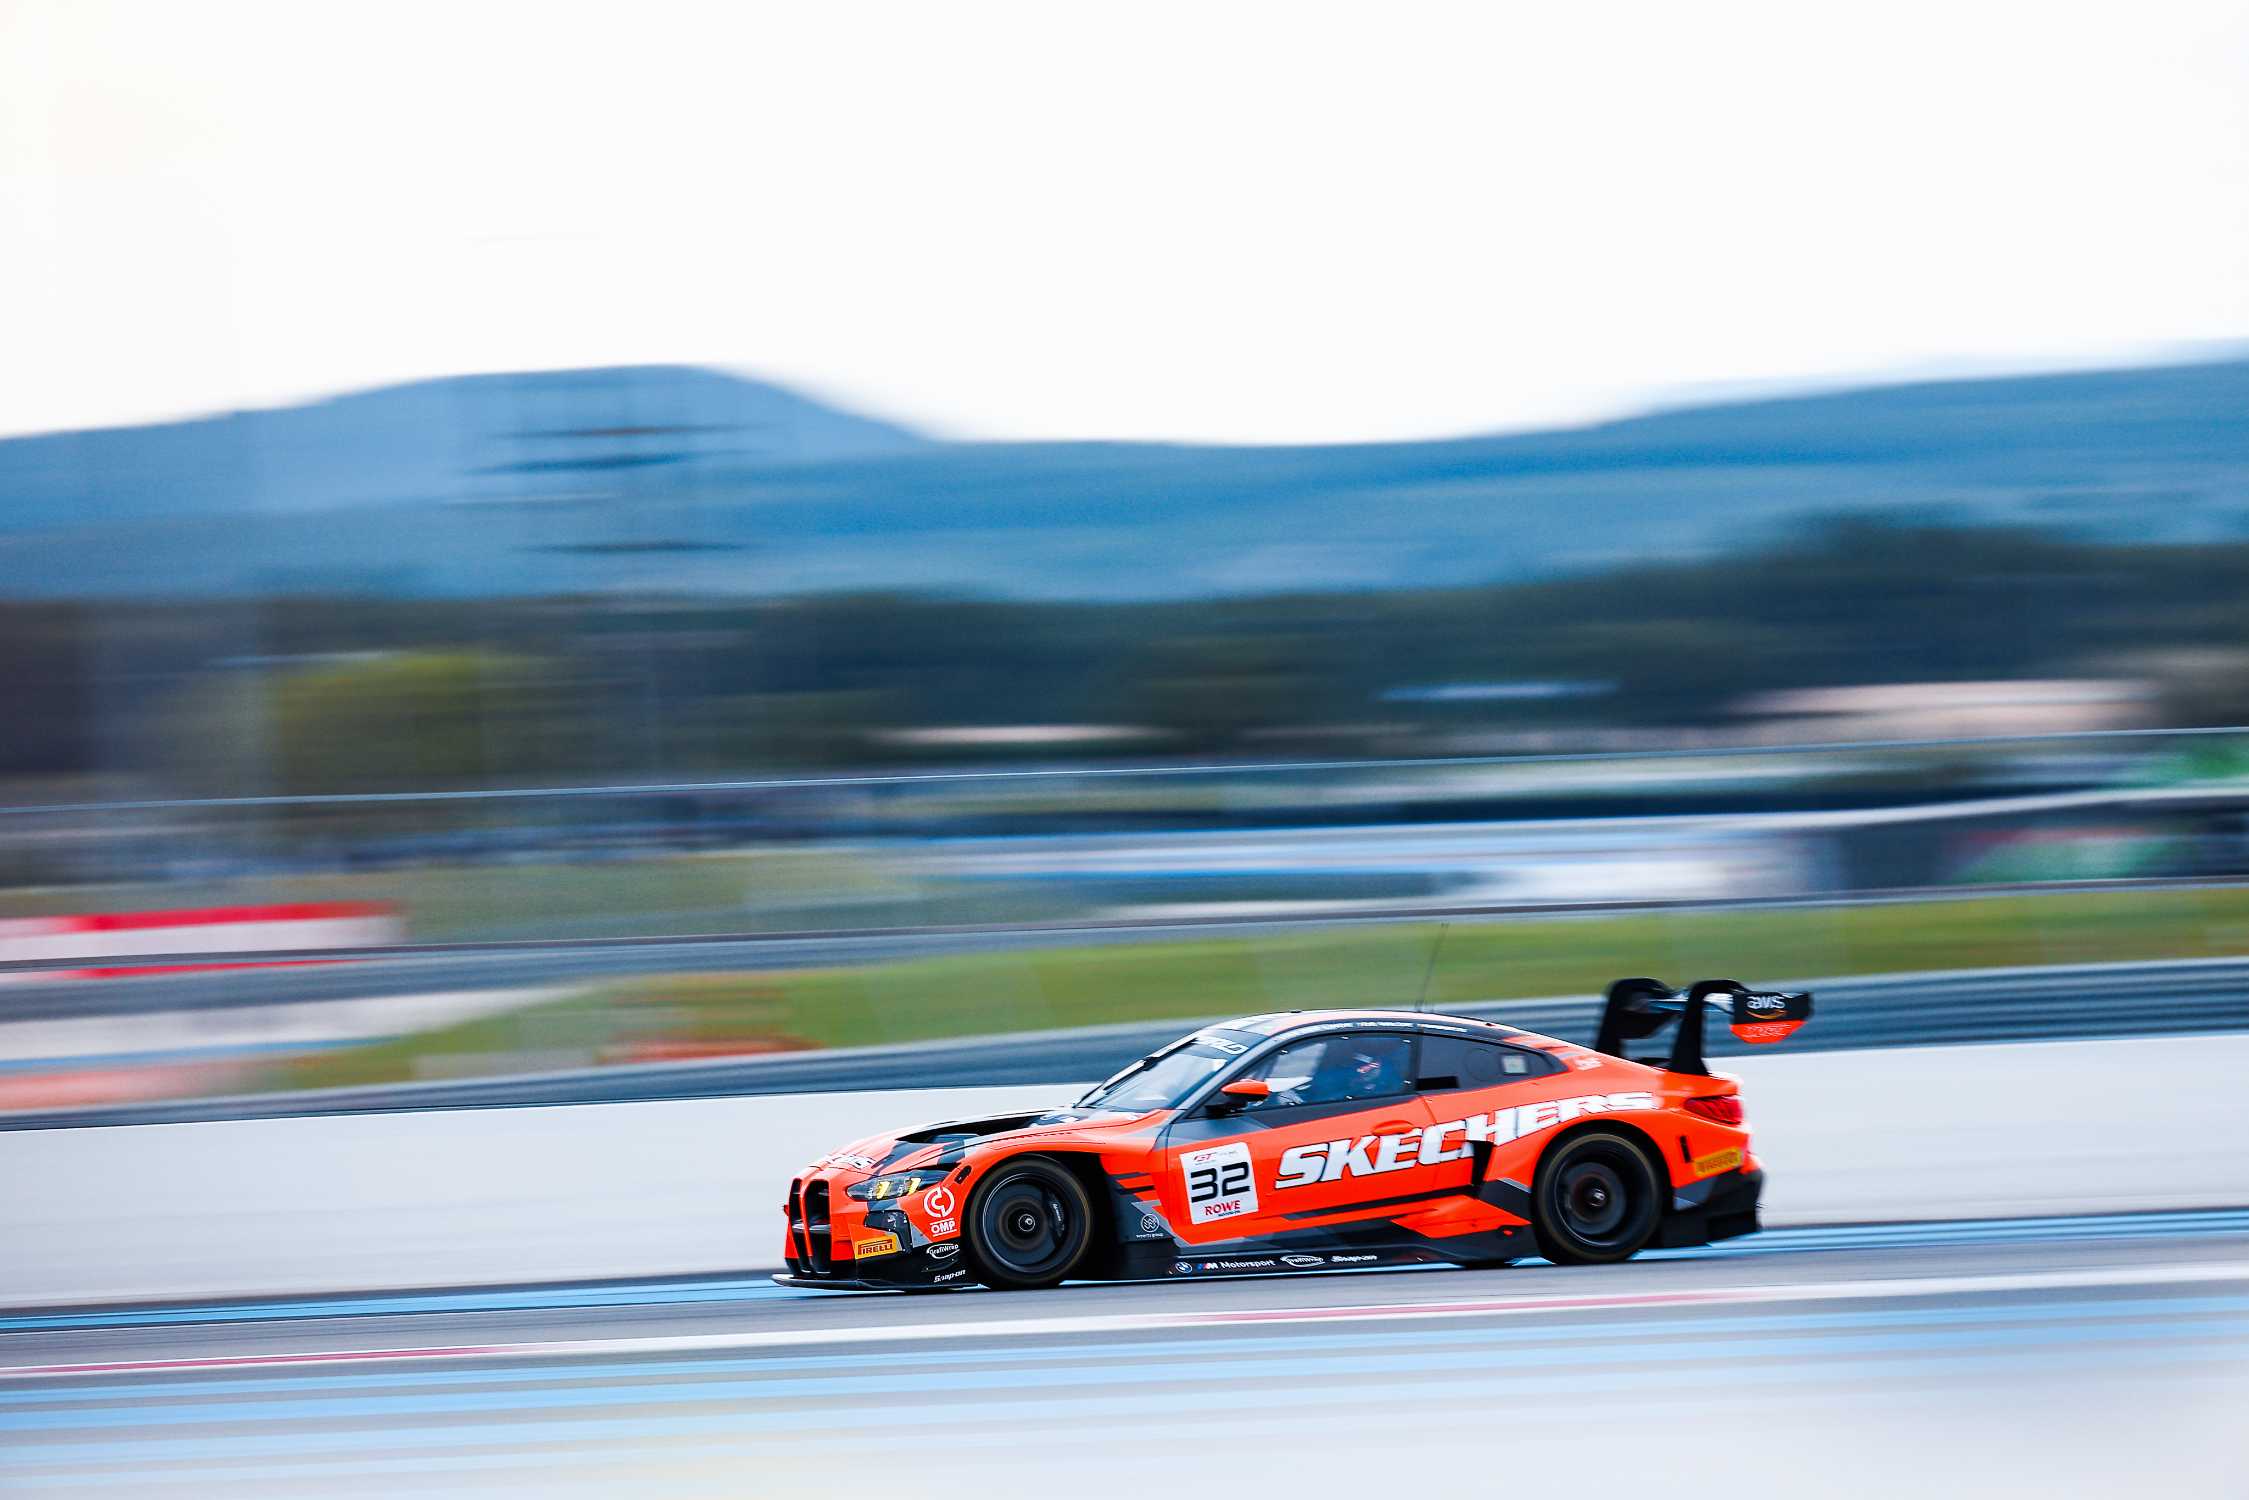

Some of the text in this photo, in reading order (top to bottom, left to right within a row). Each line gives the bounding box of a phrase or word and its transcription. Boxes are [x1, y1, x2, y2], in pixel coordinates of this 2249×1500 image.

[1274, 1091, 1661, 1190] SKECHERS
[1190, 1162, 1251, 1204] 32
[1204, 1199, 1241, 1216] ROWE
[931, 1220, 956, 1234] OMP
[857, 1239, 894, 1256] PIRELLI
[1221, 1259, 1276, 1270] Motorsport
[933, 1269, 967, 1283] Snap-on
